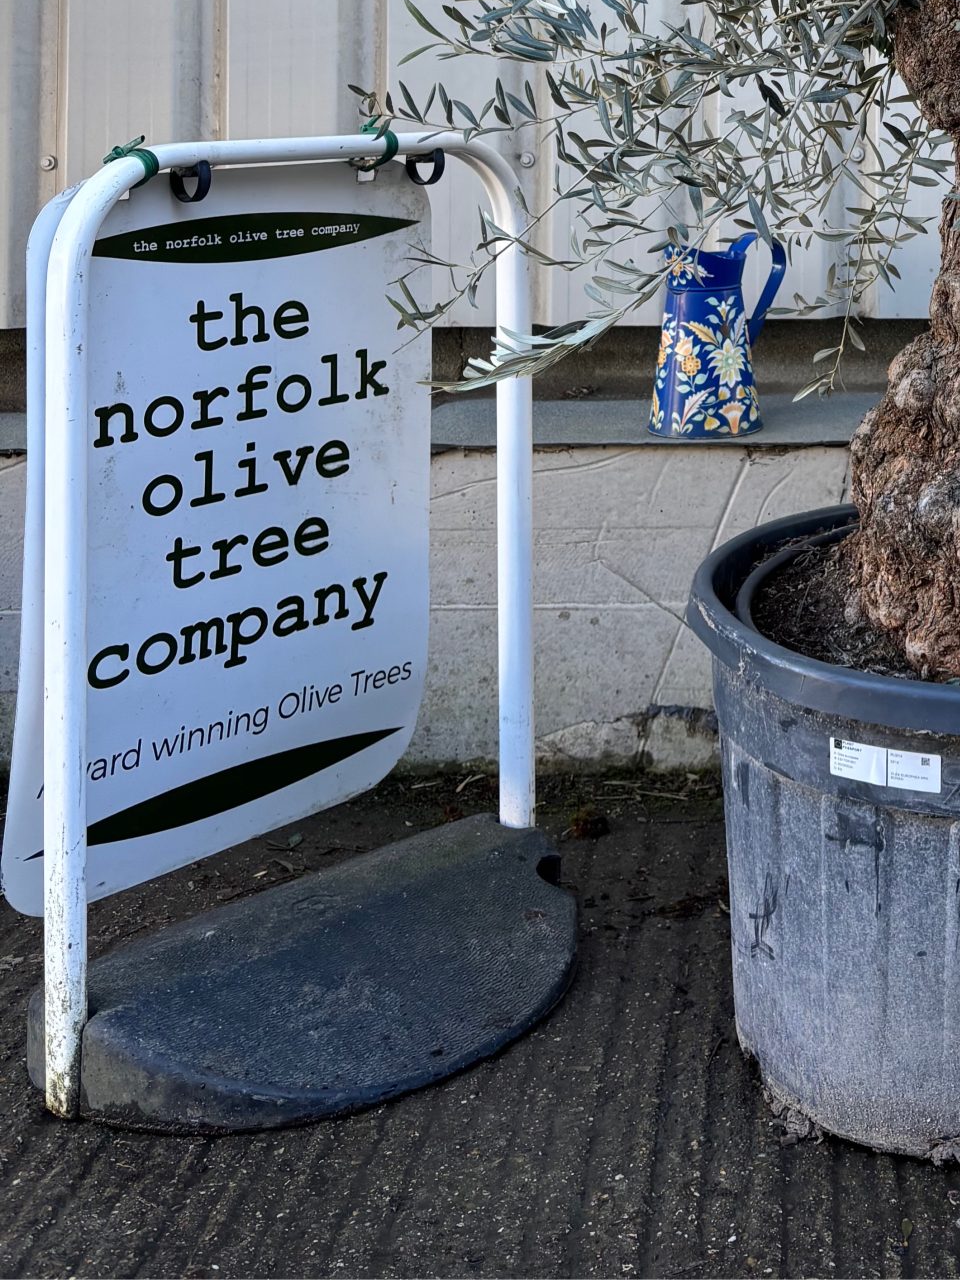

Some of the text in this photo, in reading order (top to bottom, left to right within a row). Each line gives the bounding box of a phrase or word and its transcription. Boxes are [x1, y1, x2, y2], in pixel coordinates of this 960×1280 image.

[133, 221, 360, 253] the norfolk olive tree company
[188, 292, 310, 352] the
[93, 348, 390, 449] norfolk
[141, 439, 350, 517] olive
[165, 516, 330, 589] tree
[87, 571, 388, 690] company
[152, 705, 270, 762] winning
[277, 684, 343, 720] Olive
[350, 661, 413, 697] Trees
